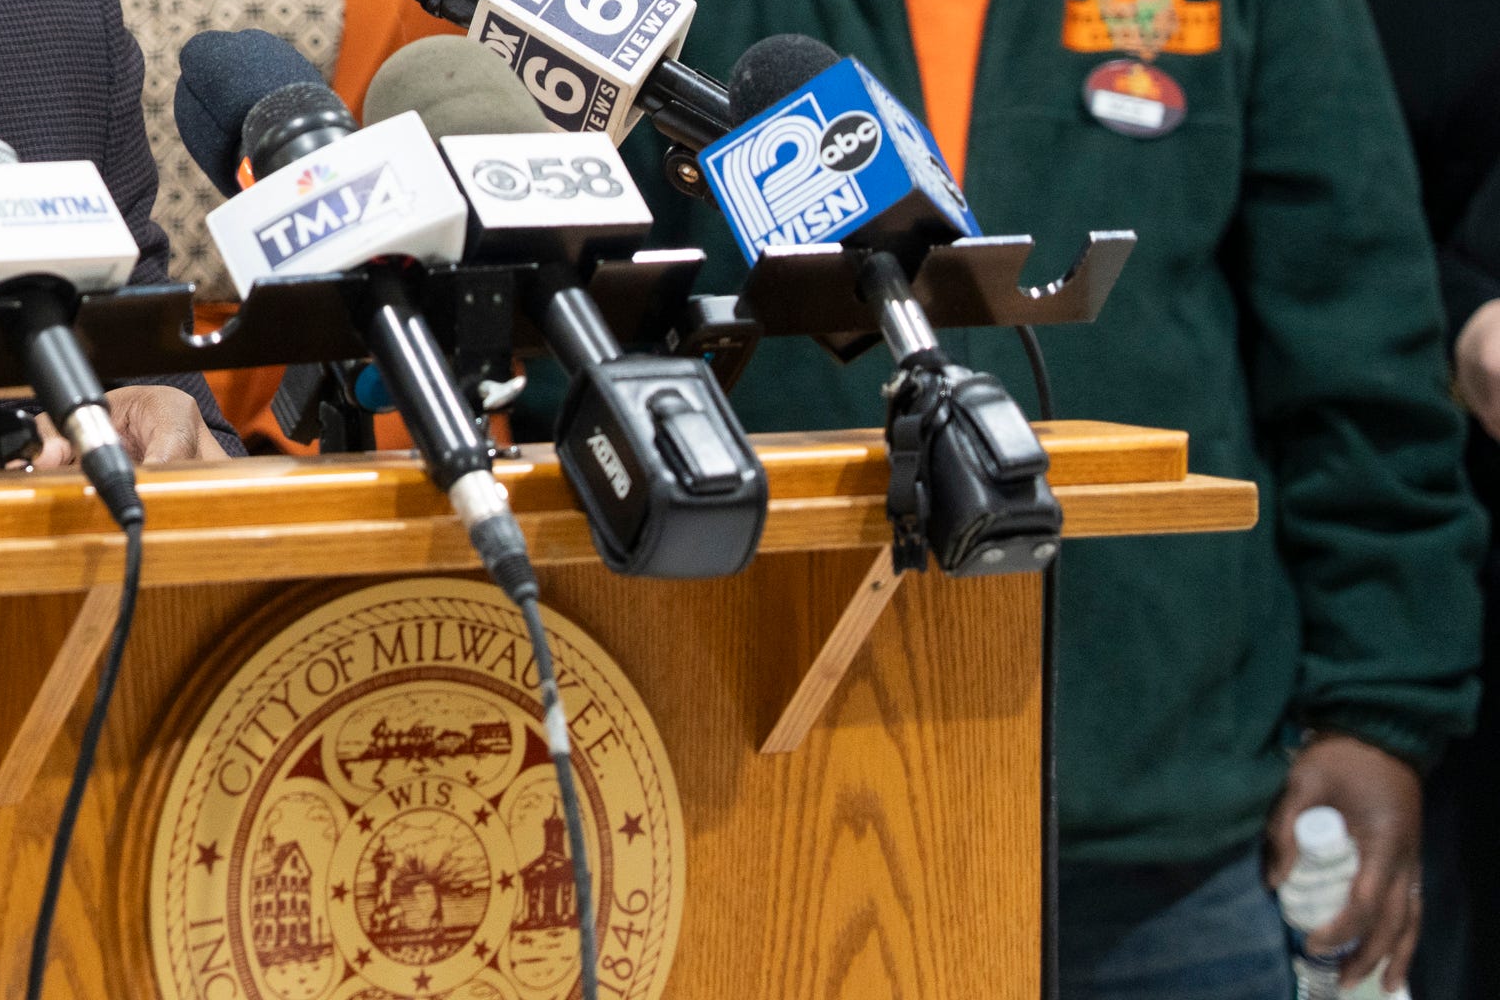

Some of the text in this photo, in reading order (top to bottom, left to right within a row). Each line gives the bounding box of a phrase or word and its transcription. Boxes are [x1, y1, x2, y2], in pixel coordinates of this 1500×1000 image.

[617, 0, 676, 66] NEWS
[487, 20, 521, 67] OX
[522, 55, 587, 115] 6
[820, 120, 879, 167] abc
[527, 156, 624, 200] 58
[754, 183, 862, 251] WISN
[218, 682, 301, 797] CITY
[305, 641, 356, 696] OF
[387, 780, 457, 813] WIS.
[596, 889, 650, 998] 1846
